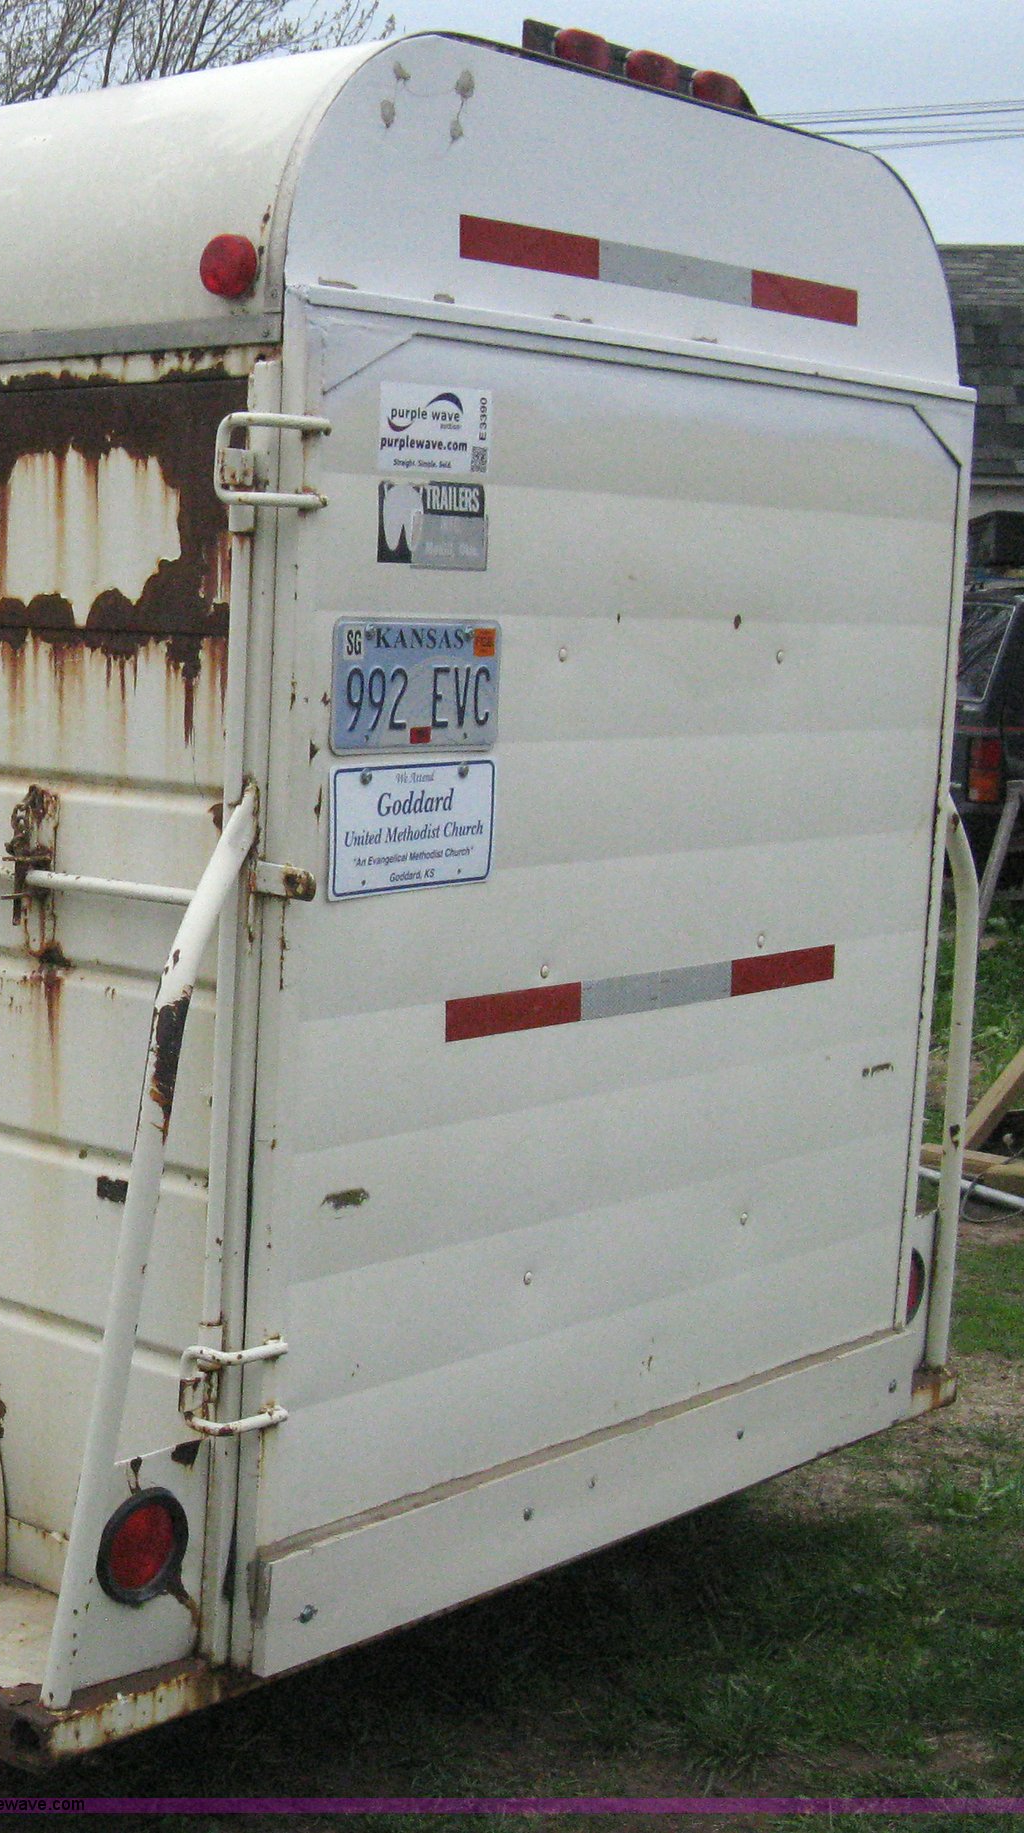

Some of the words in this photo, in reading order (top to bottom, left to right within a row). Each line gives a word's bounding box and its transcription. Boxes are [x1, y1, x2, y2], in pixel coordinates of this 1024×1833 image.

[391, 407, 428, 421] purple
[431, 411, 460, 422] wave
[380, 435, 468, 452] purplewave.com
[425, 485, 481, 513] TRAILERS
[346, 629, 362, 656] SG
[375, 627, 465, 649] KANSAS
[346, 667, 409, 732] 992
[431, 666, 491, 728] EVC
[377, 787, 455, 817] Goddard
[344, 828, 381, 848] United
[385, 823, 441, 844] Methodist
[443, 819, 484, 838] Church
[367, 852, 408, 867] Evangelical
[409, 849, 443, 861] Methodist
[389, 871, 422, 883] Goddard,
[424, 868, 435, 878] KS
